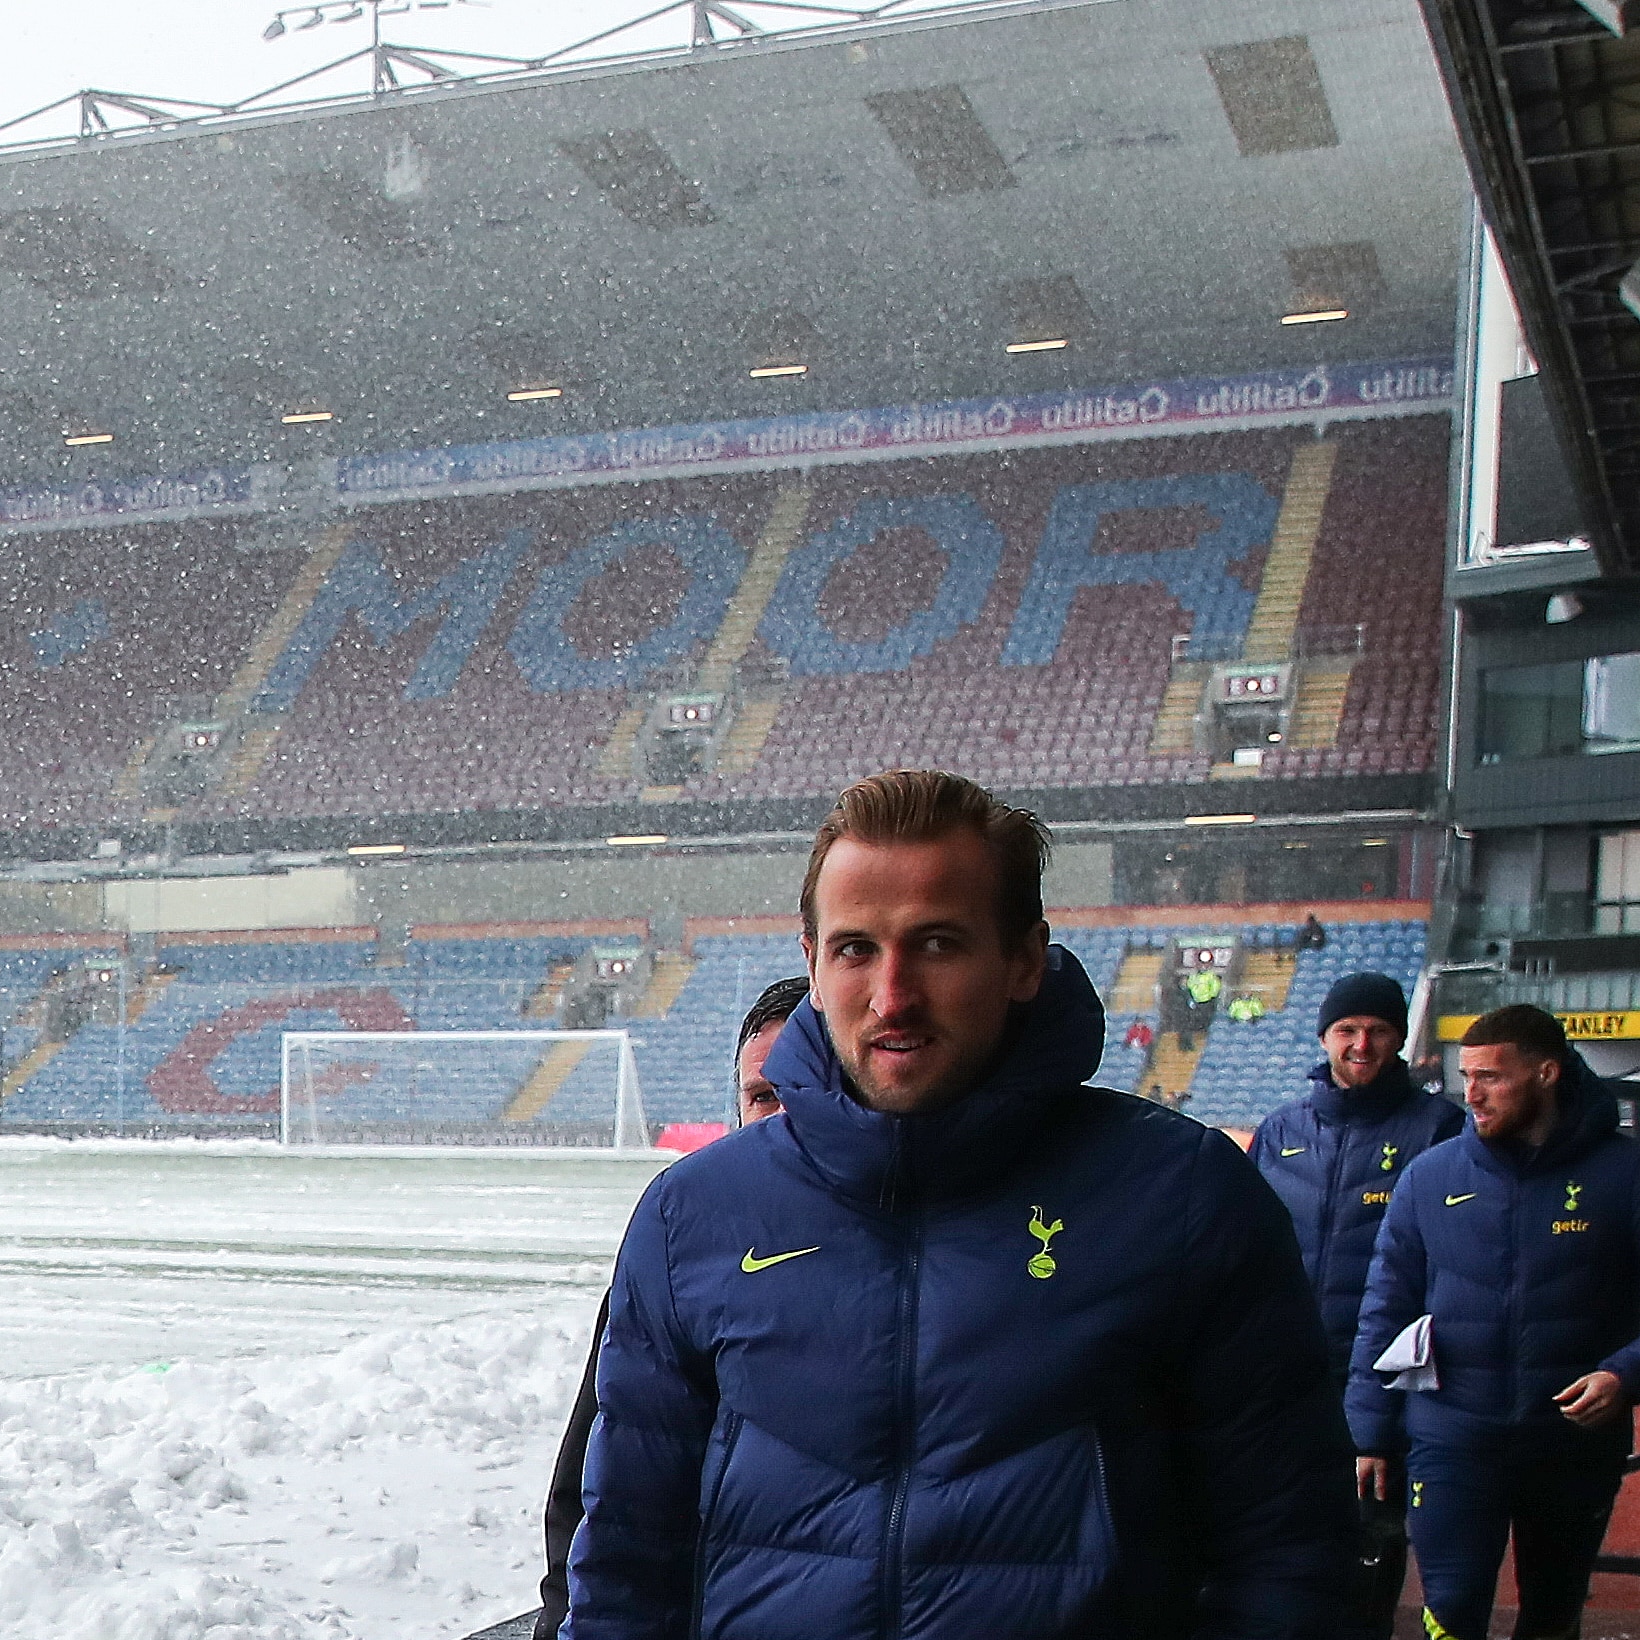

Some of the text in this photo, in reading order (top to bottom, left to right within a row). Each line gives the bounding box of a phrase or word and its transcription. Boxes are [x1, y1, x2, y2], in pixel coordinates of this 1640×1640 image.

[1040, 396, 1140, 430] utilita
[1195, 381, 1300, 416] utilita
[248, 472, 1276, 710] MOOR
[1552, 1219, 1590, 1235] getir
